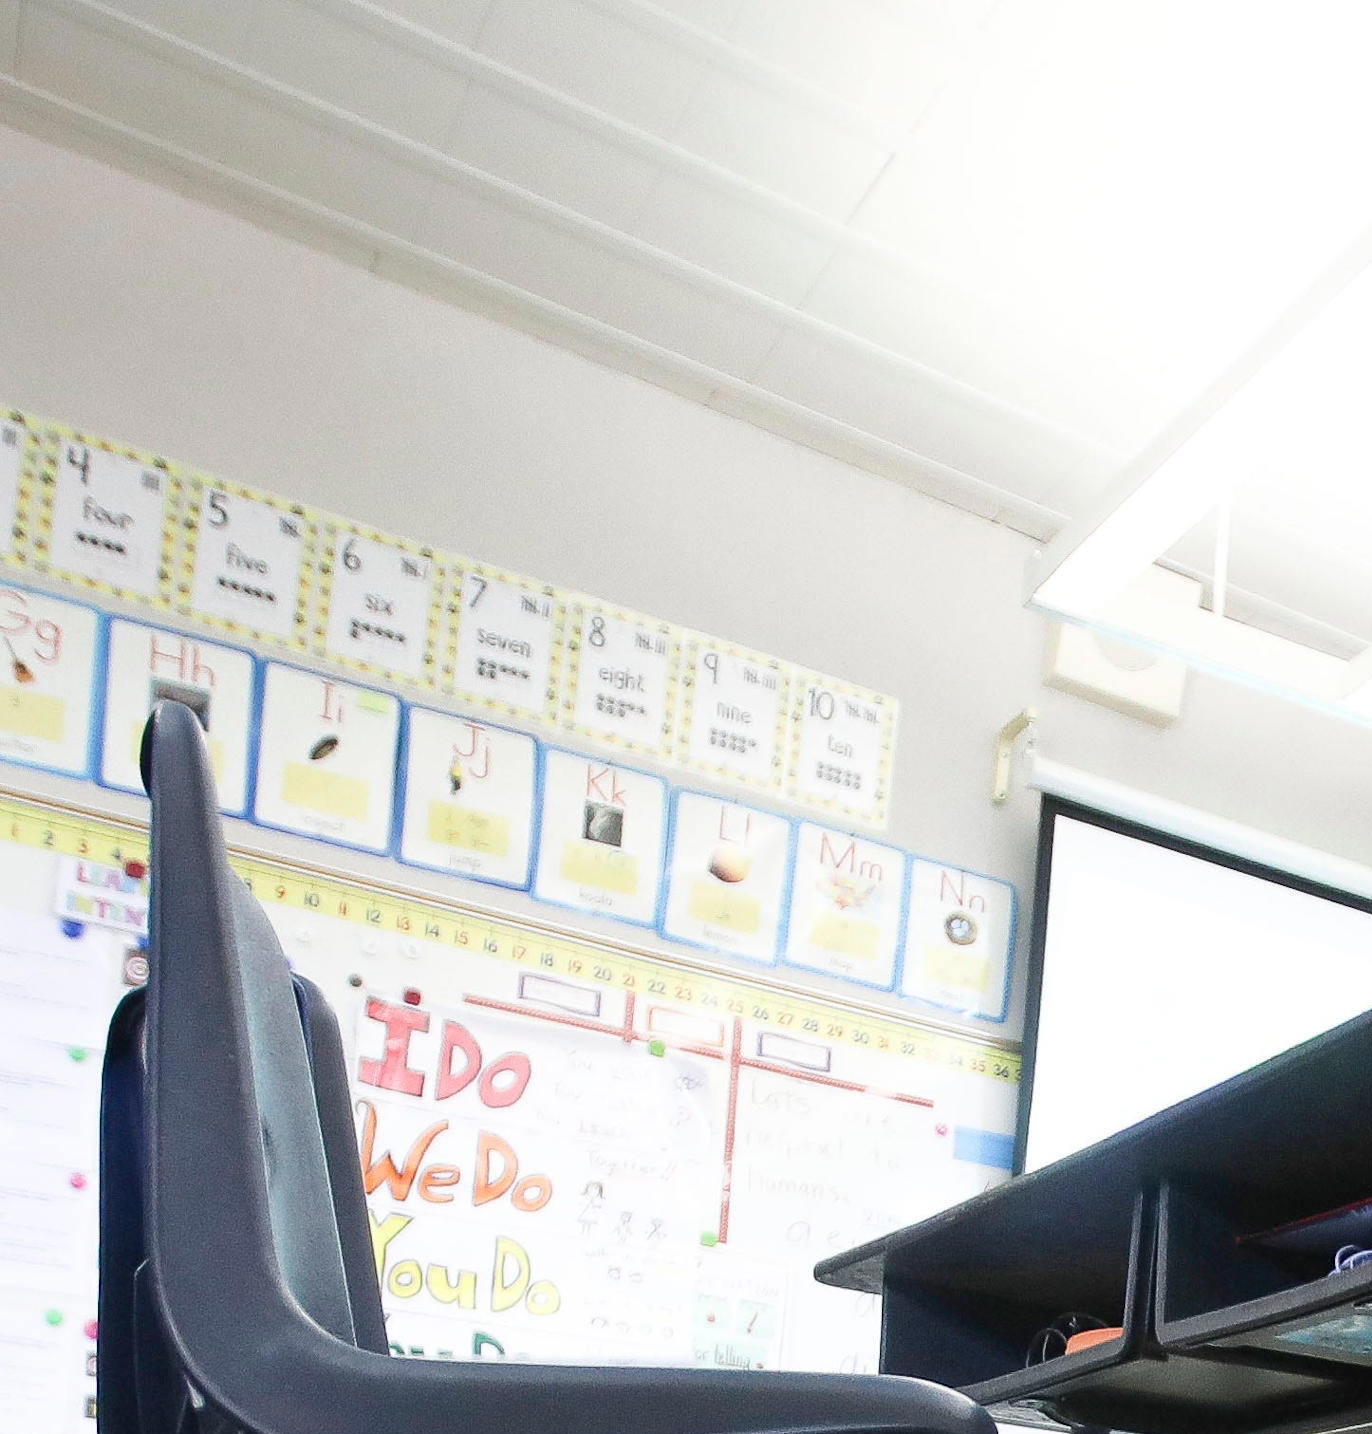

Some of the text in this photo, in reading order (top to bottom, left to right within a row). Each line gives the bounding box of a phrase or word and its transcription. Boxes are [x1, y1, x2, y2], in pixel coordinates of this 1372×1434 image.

[67, 447, 90, 485] 4
[208, 490, 229, 527] 5
[342, 537, 362, 572] 6
[364, 592, 394, 616] six
[470, 576, 488, 609] 7
[476, 627, 532, 659] seven
[588, 616, 606, 648] 8
[150, 634, 216, 687] Hh
[599, 665, 646, 693] eight
[703, 652, 720, 685] 9
[715, 700, 752, 725] nine
[807, 686, 835, 721] 10
[453, 722, 494, 780] Jj
[826, 733, 854, 759] ten
[586, 763, 628, 807] Kk
[819, 831, 884, 882] Mm
[940, 870, 986, 913] Nn
[44, 828, 55, 847] 2
[77, 837, 90, 855] 3
[274, 884, 287, 900] 9
[304, 890, 321, 909] 10
[338, 902, 348, 917] 11
[365, 908, 382, 925] 12
[396, 915, 412, 932] 13
[424, 922, 440, 938] 14
[454, 929, 469, 946] 15
[483, 938, 498, 955] 16
[512, 945, 528, 961] 17
[540, 951, 556, 969] 18
[567, 959, 584, 975] 19
[593, 965, 613, 983] 20
[621, 972, 637, 989] 21
[646, 978, 668, 997] 22
[673, 985, 694, 1002] 23
[699, 992, 719, 1008] 24
[725, 998, 745, 1015] 25
[752, 1004, 770, 1021] 26
[776, 1010, 794, 1026] 27
[802, 1016, 820, 1034] 28
[826, 1023, 845, 1039] 29
[852, 1029, 870, 1045] 30
[901, 1040, 916, 1056] 32
[970, 1059, 987, 1073] 35
[993, 1062, 1010, 1080] 36
[358, 997, 430, 1097] I
[355, 1099, 461, 1203] We
[368, 1208, 478, 1311] You
